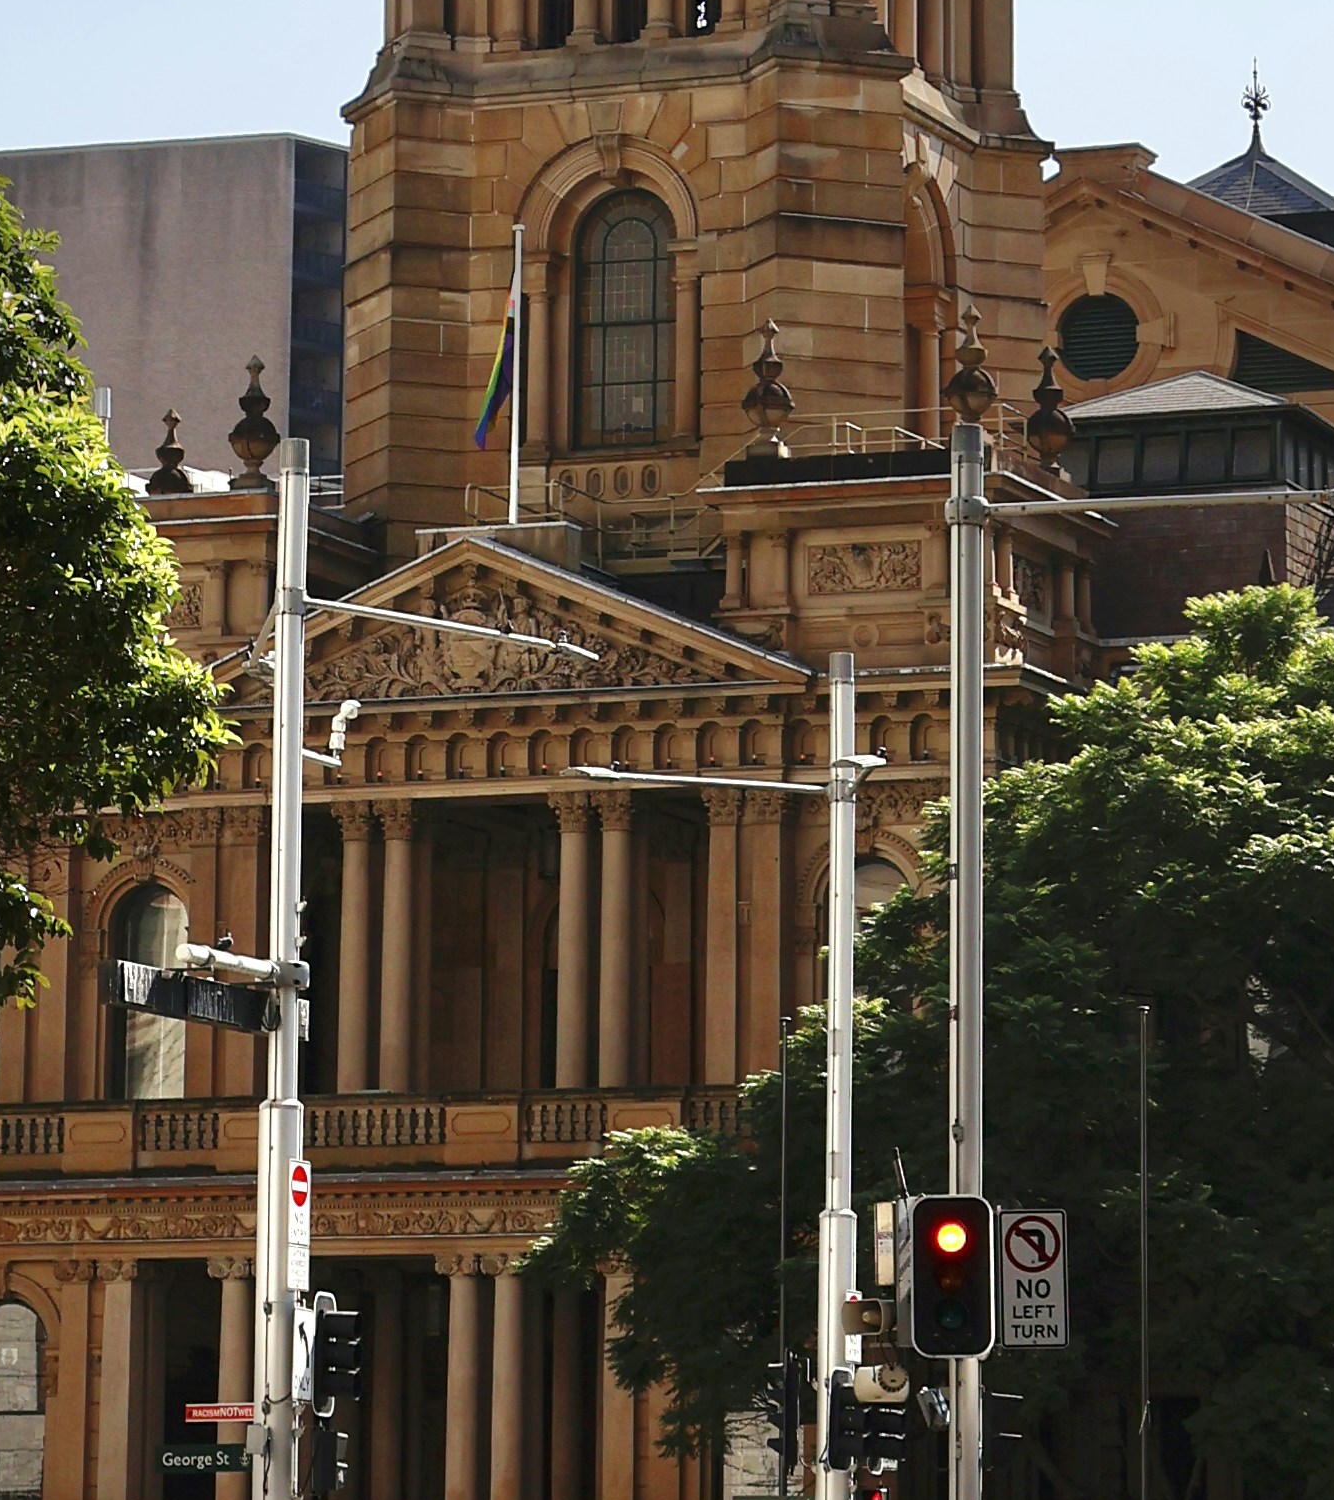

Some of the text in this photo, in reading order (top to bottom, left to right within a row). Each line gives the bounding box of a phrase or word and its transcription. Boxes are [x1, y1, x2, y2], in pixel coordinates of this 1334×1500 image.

[1016, 1279, 1051, 1299] NO
[1012, 1305, 1056, 1319] LEFT
[1011, 1324, 1058, 1338] TURN
[162, 1450, 230, 1470] George St
